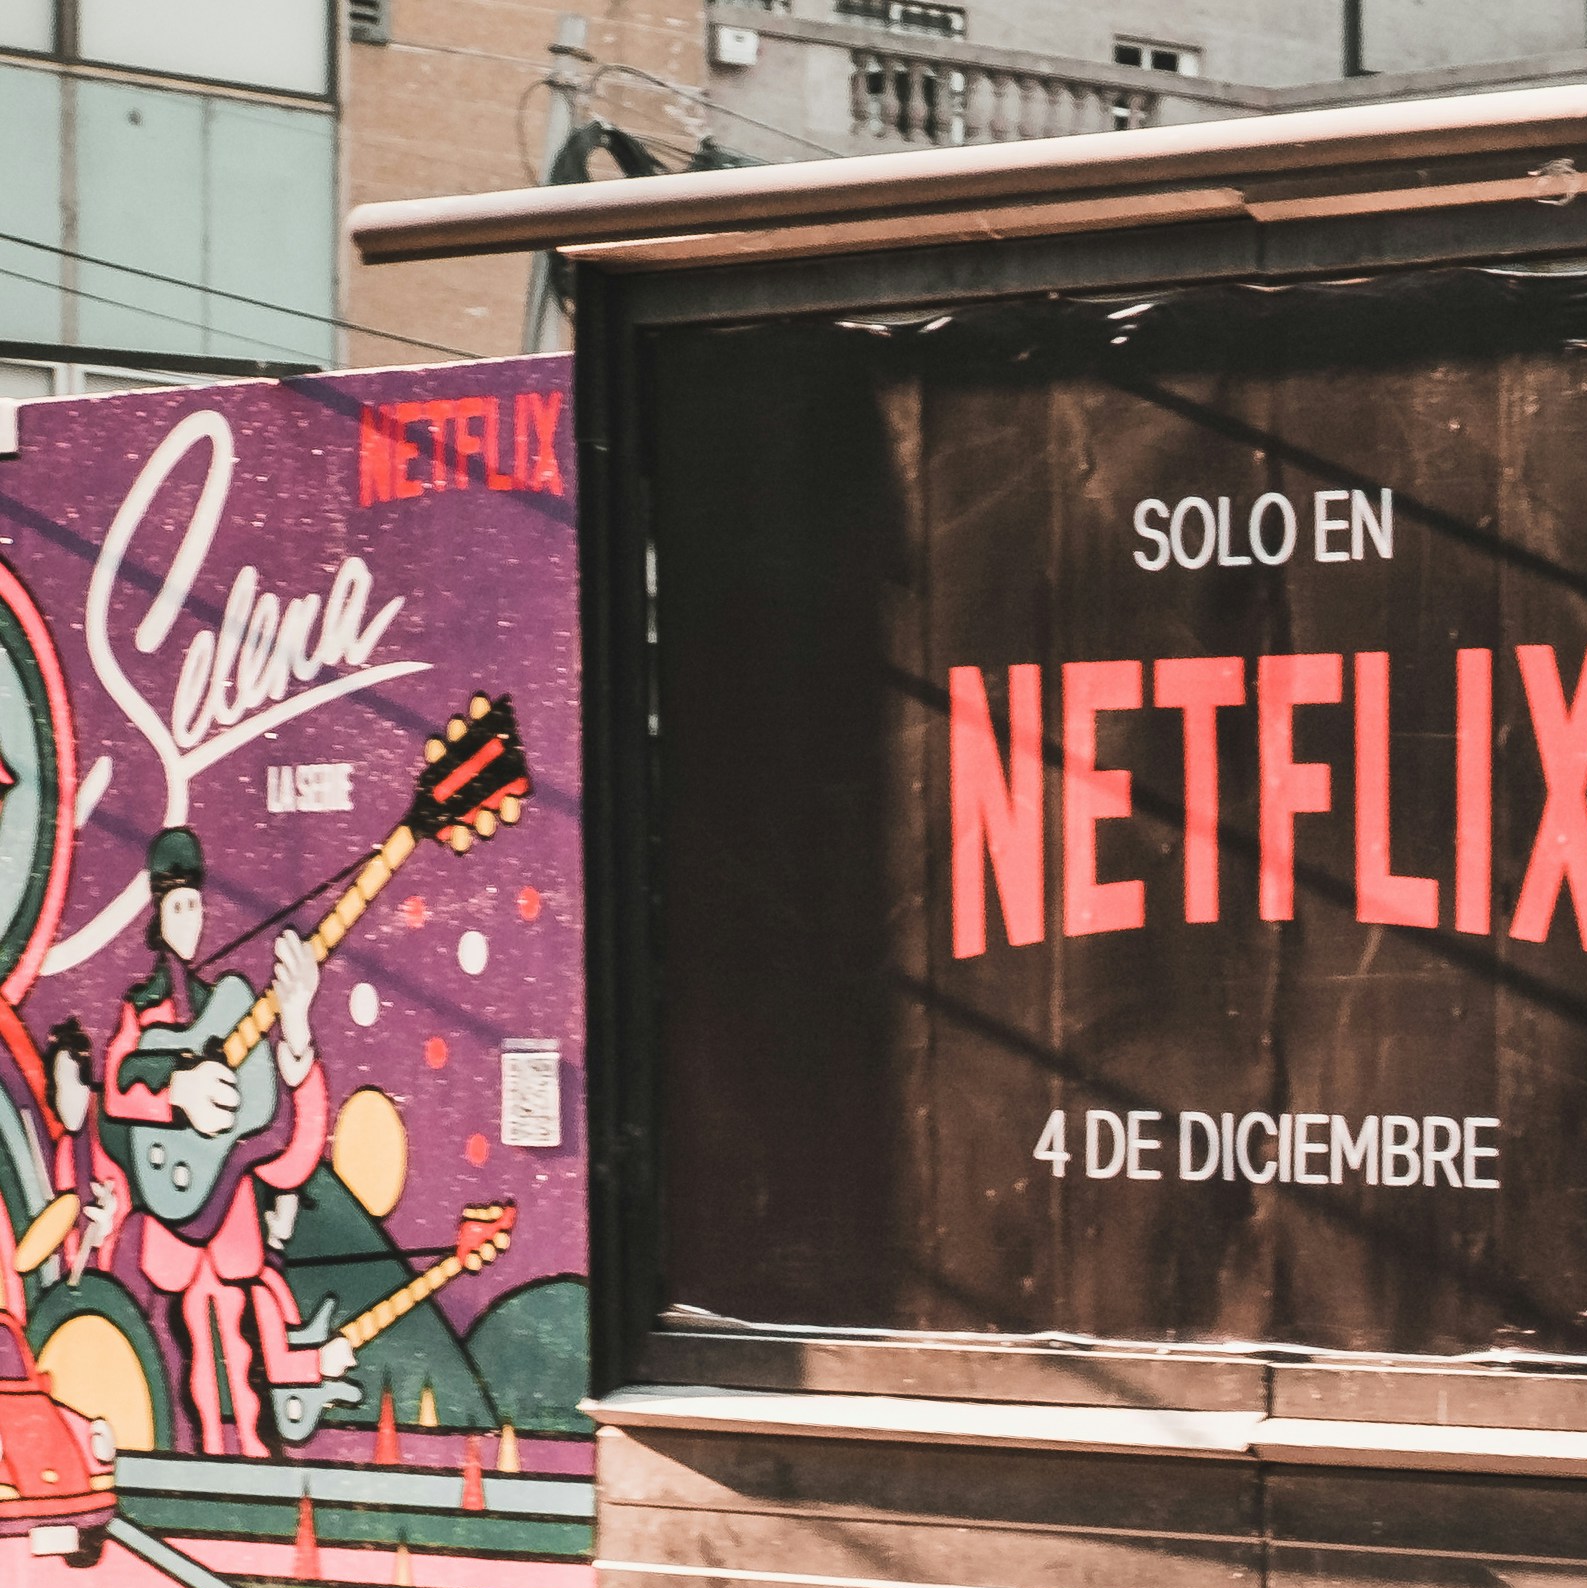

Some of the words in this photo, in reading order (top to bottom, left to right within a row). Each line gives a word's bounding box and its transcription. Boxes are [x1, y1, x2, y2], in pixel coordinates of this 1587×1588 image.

[359, 391, 564, 507] NETFLIX
[1133, 492, 1297, 571] SOLO
[1314, 488, 1393, 562] EN
[40, 410, 434, 976] Selena
[1033, 1109, 1070, 1178] 4
[1086, 1110, 1162, 1180] DE
[1179, 1111, 1500, 1189] DICIEMBRE
